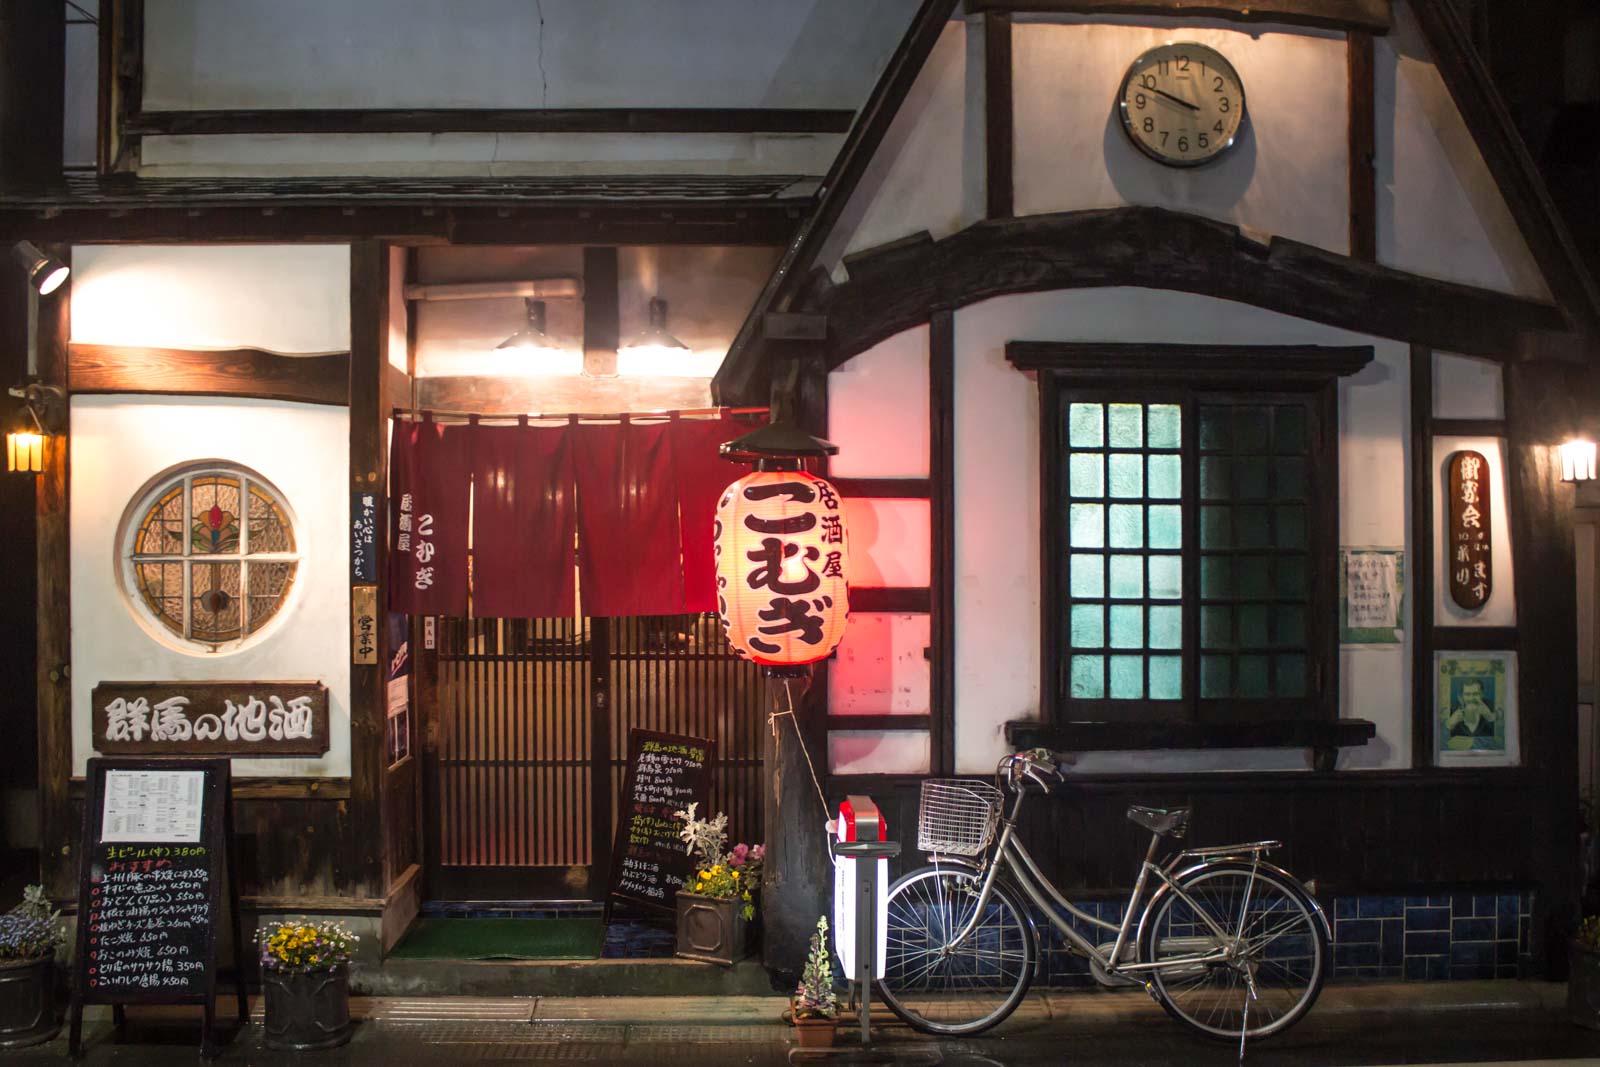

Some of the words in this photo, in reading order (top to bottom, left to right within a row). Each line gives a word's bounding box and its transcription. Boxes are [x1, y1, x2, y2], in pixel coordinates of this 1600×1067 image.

[1157, 60, 1169, 76] 11
[1174, 55, 1190, 71] 12
[1200, 61, 1206, 77] 1
[1141, 74, 1157, 90] 10
[1213, 76, 1224, 93] 2
[1135, 93, 1146, 110] 9
[1219, 97, 1230, 113] 3
[1143, 117, 1154, 133] 8
[1213, 119, 1224, 135] 4
[1160, 131, 1170, 148] 7
[1178, 136, 1189, 152] 6
[1198, 132, 1209, 149] 5
[362, 495, 375, 544] 暖かい心は
[398, 494, 412, 552] 居酒屋
[812, 480, 843, 579] 居酒屋
[415, 514, 435, 590] こむぎ
[743, 482, 833, 654] こむぎ
[357, 615, 375, 660] 営業中
[426, 620, 434, 647] 出入口
[104, 695, 313, 742] 群馬の地酒
[107, 847, 169, 859] 生ビール(中)
[175, 848, 205, 857] 380円
[110, 860, 171, 871] おすすめ
[177, 893, 204, 901] 550円
[101, 934, 135, 945] たこ焼
[99, 948, 154, 960] おこのみ焼
[178, 961, 204, 971] 350円
[163, 977, 188, 986] 450円
